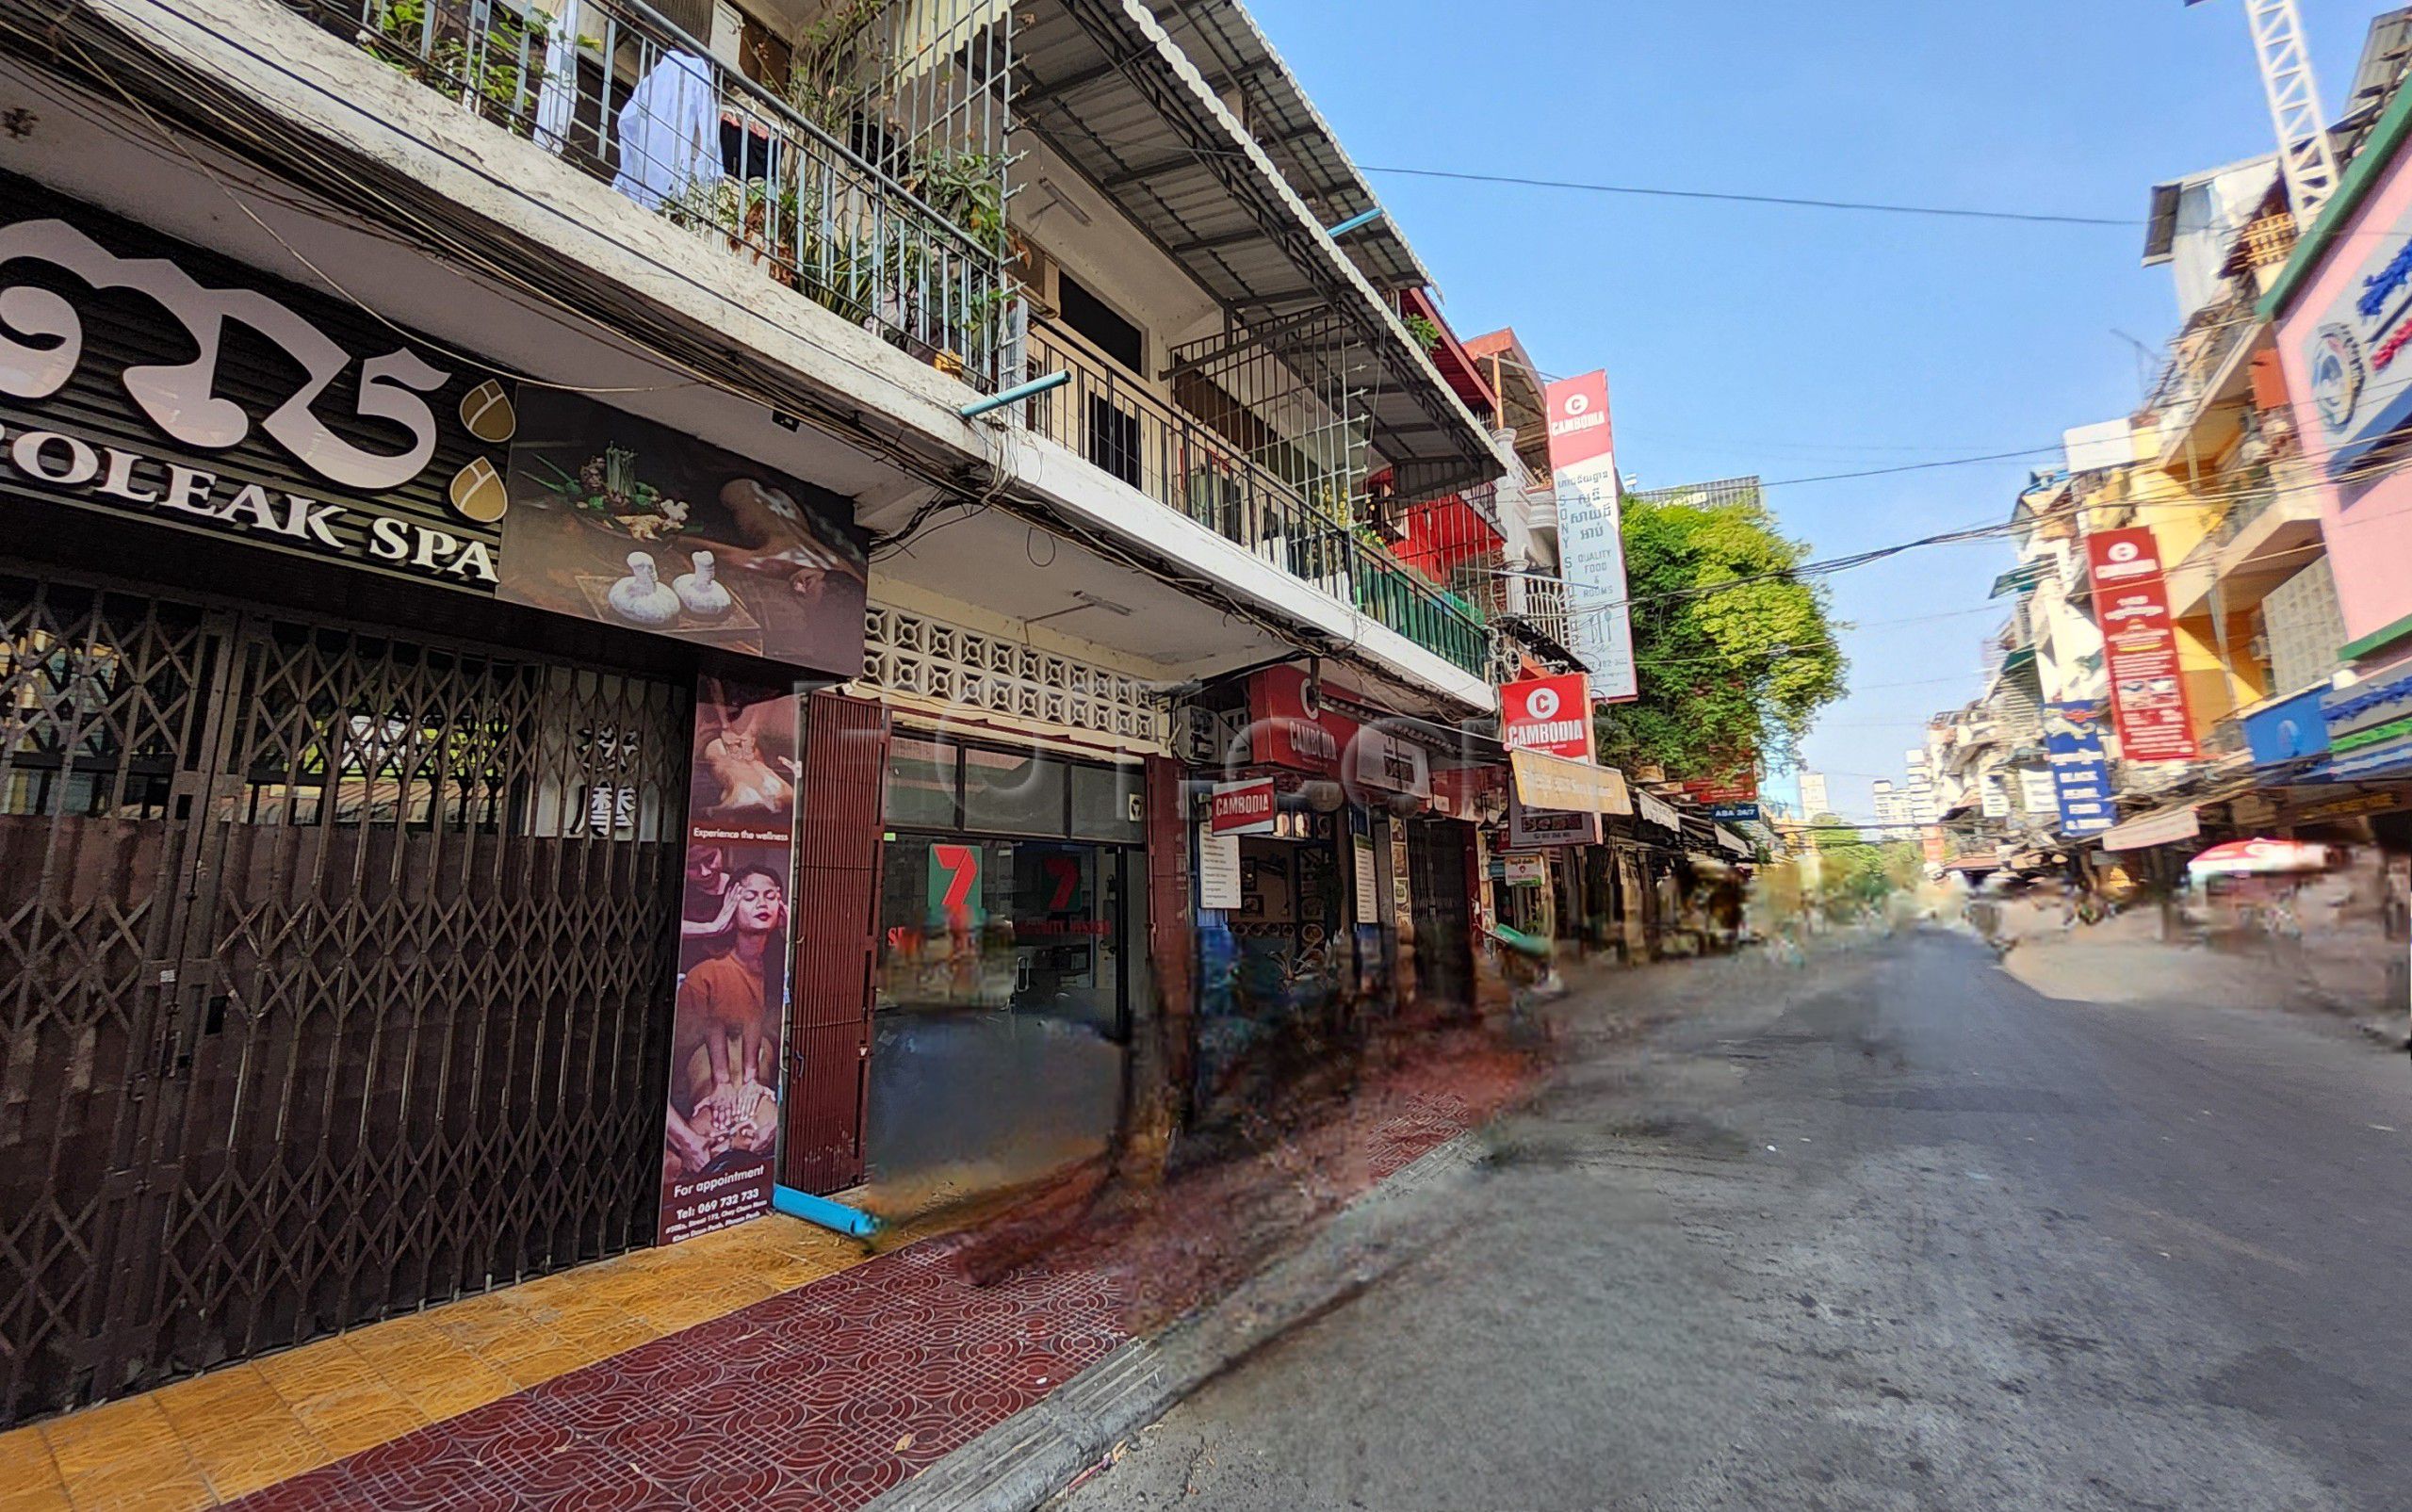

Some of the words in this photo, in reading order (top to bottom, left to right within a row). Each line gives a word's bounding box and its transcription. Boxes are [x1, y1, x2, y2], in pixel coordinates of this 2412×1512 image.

[1552, 411, 1605, 436] CAMBODIA
[0, 430, 348, 550] OLEAK
[368, 516, 501, 584] SPA
[1558, 495, 1570, 548] SONY
[1577, 549, 1612, 562] QUALITY
[1585, 562, 1607, 574] FOOD
[1583, 585, 1613, 598] ROOMS
[1508, 720, 1584, 745] CAMBODIA
[1215, 793, 1269, 817] CAMBODIA
[693, 827, 740, 838] Experience
[741, 829, 754, 839] the
[756, 831, 790, 841] wellness
[674, 1184, 694, 1198] For
[695, 1164, 764, 1193] appointment
[676, 1207, 695, 1220] Tel:
[698, 1200, 718, 1214] 069
[720, 1195, 739, 1208] 732
[742, 1188, 759, 1201] 733
